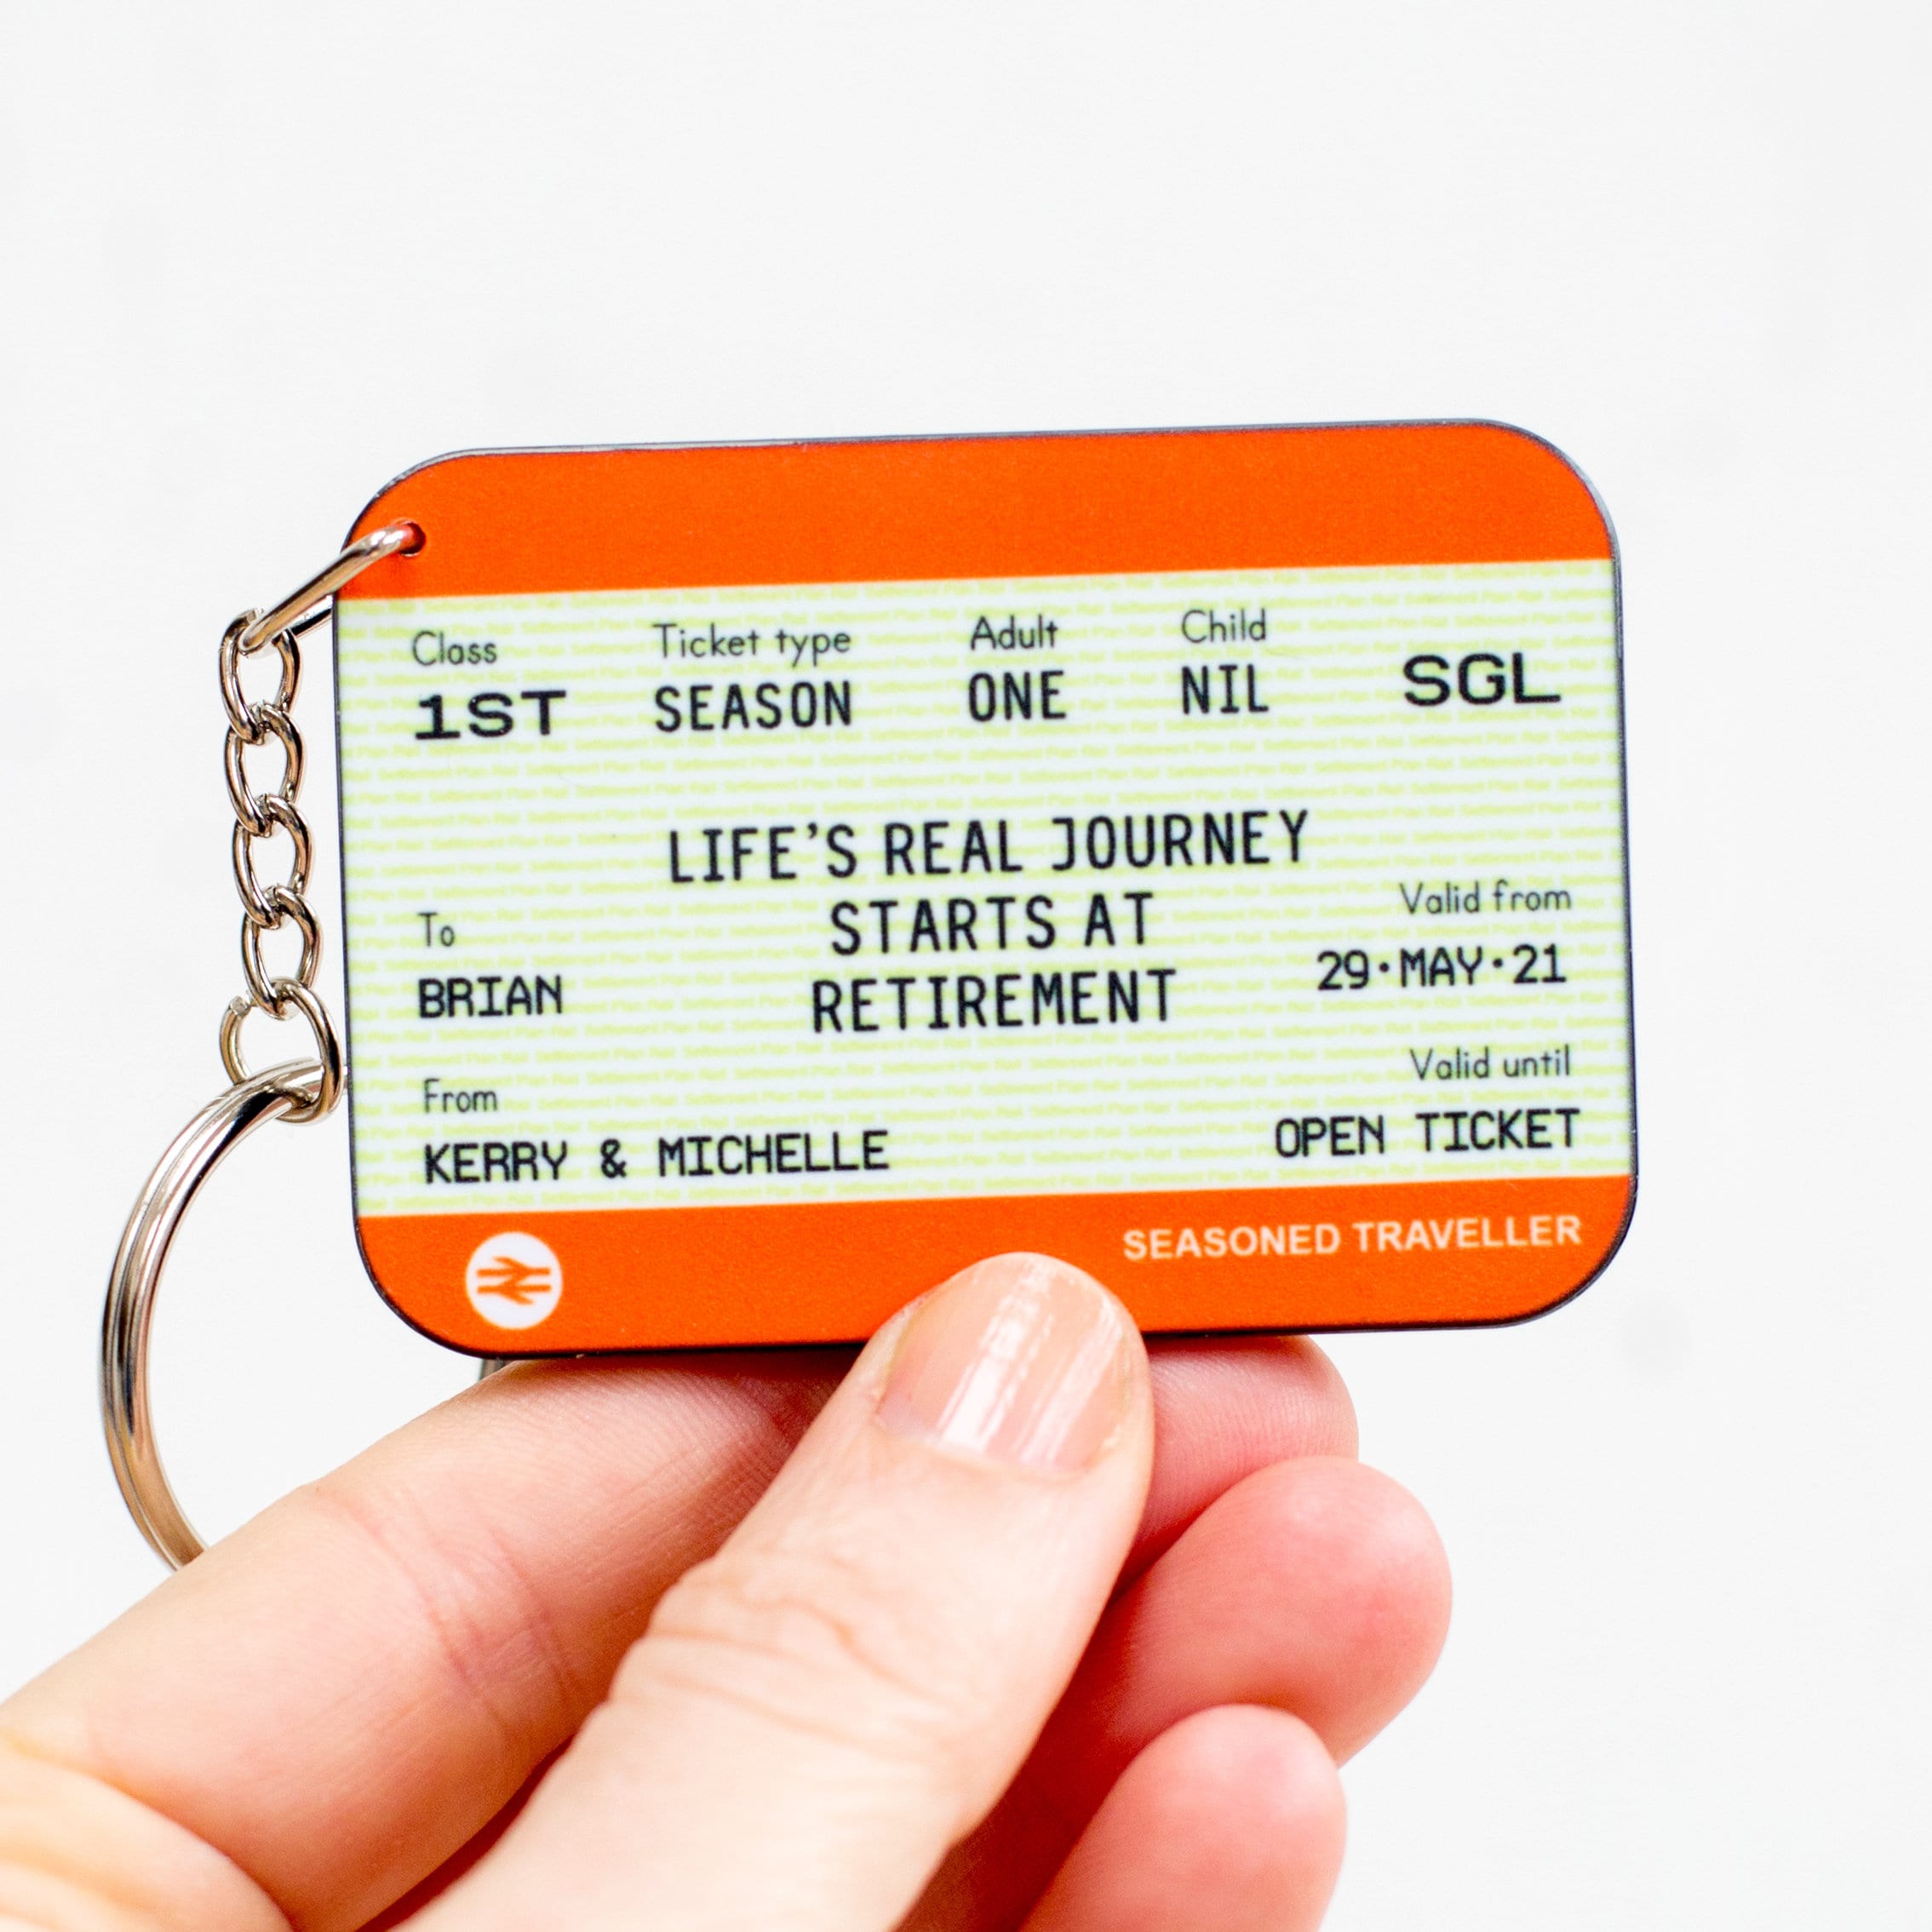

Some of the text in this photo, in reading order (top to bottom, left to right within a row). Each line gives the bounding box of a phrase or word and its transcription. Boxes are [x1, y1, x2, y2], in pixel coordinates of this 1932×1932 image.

[411, 630, 497, 667] Class
[652, 622, 851, 668] Ticket type
[970, 614, 1058, 651] Adult
[1181, 608, 1267, 645] Child
[967, 669, 1067, 723] ONE
[1181, 663, 1270, 716] NIL
[1402, 651, 1562, 708] SGL
[414, 689, 567, 741] 1ST
[654, 679, 852, 734] SEASON
[884, 818, 1023, 877] REAL
[1051, 809, 1309, 873] JOURNEY
[1399, 878, 1571, 915] Valid from
[418, 911, 456, 948] To
[829, 891, 1154, 957] STARTS AT
[417, 974, 563, 1019] BRIAN
[811, 967, 1177, 1035] RETIREMENT
[1409, 1044, 1570, 1081] Valid until
[423, 1077, 498, 1114] From
[423, 1129, 891, 1185] KERRY & MICHELLE
[1275, 1107, 1581, 1159] OPEN TICKET
[1124, 1215, 1580, 1259] SEASONED TRAVELLER
